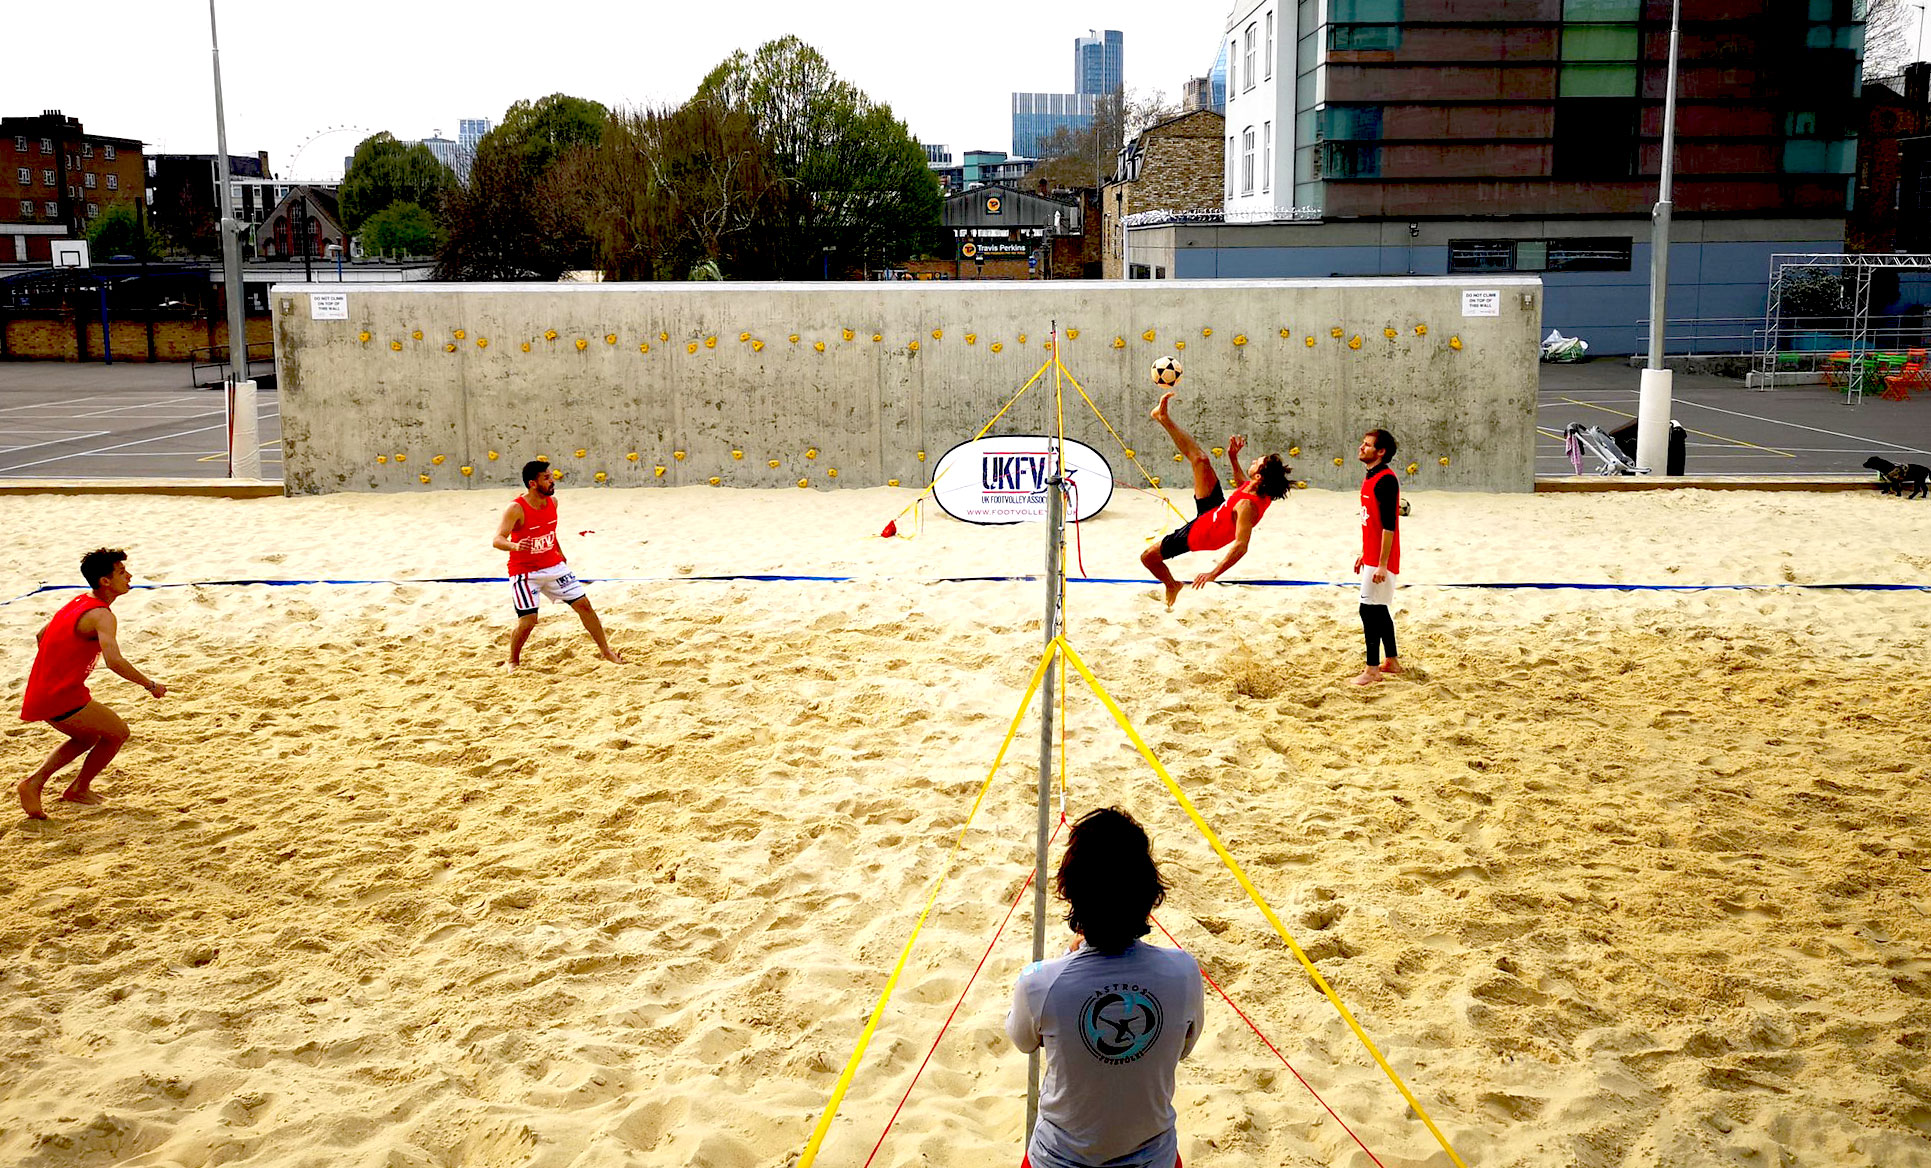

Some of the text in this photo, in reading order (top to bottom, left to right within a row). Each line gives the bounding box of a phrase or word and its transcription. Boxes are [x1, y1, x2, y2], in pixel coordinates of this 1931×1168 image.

[977, 244, 1026, 252] Travis Perkins
[982, 456, 1045, 490] UKFV
[981, 495, 990, 504] UK
[990, 495, 1026, 504] FOOTVOLLEY
[1095, 983, 1149, 998] ASTROS
